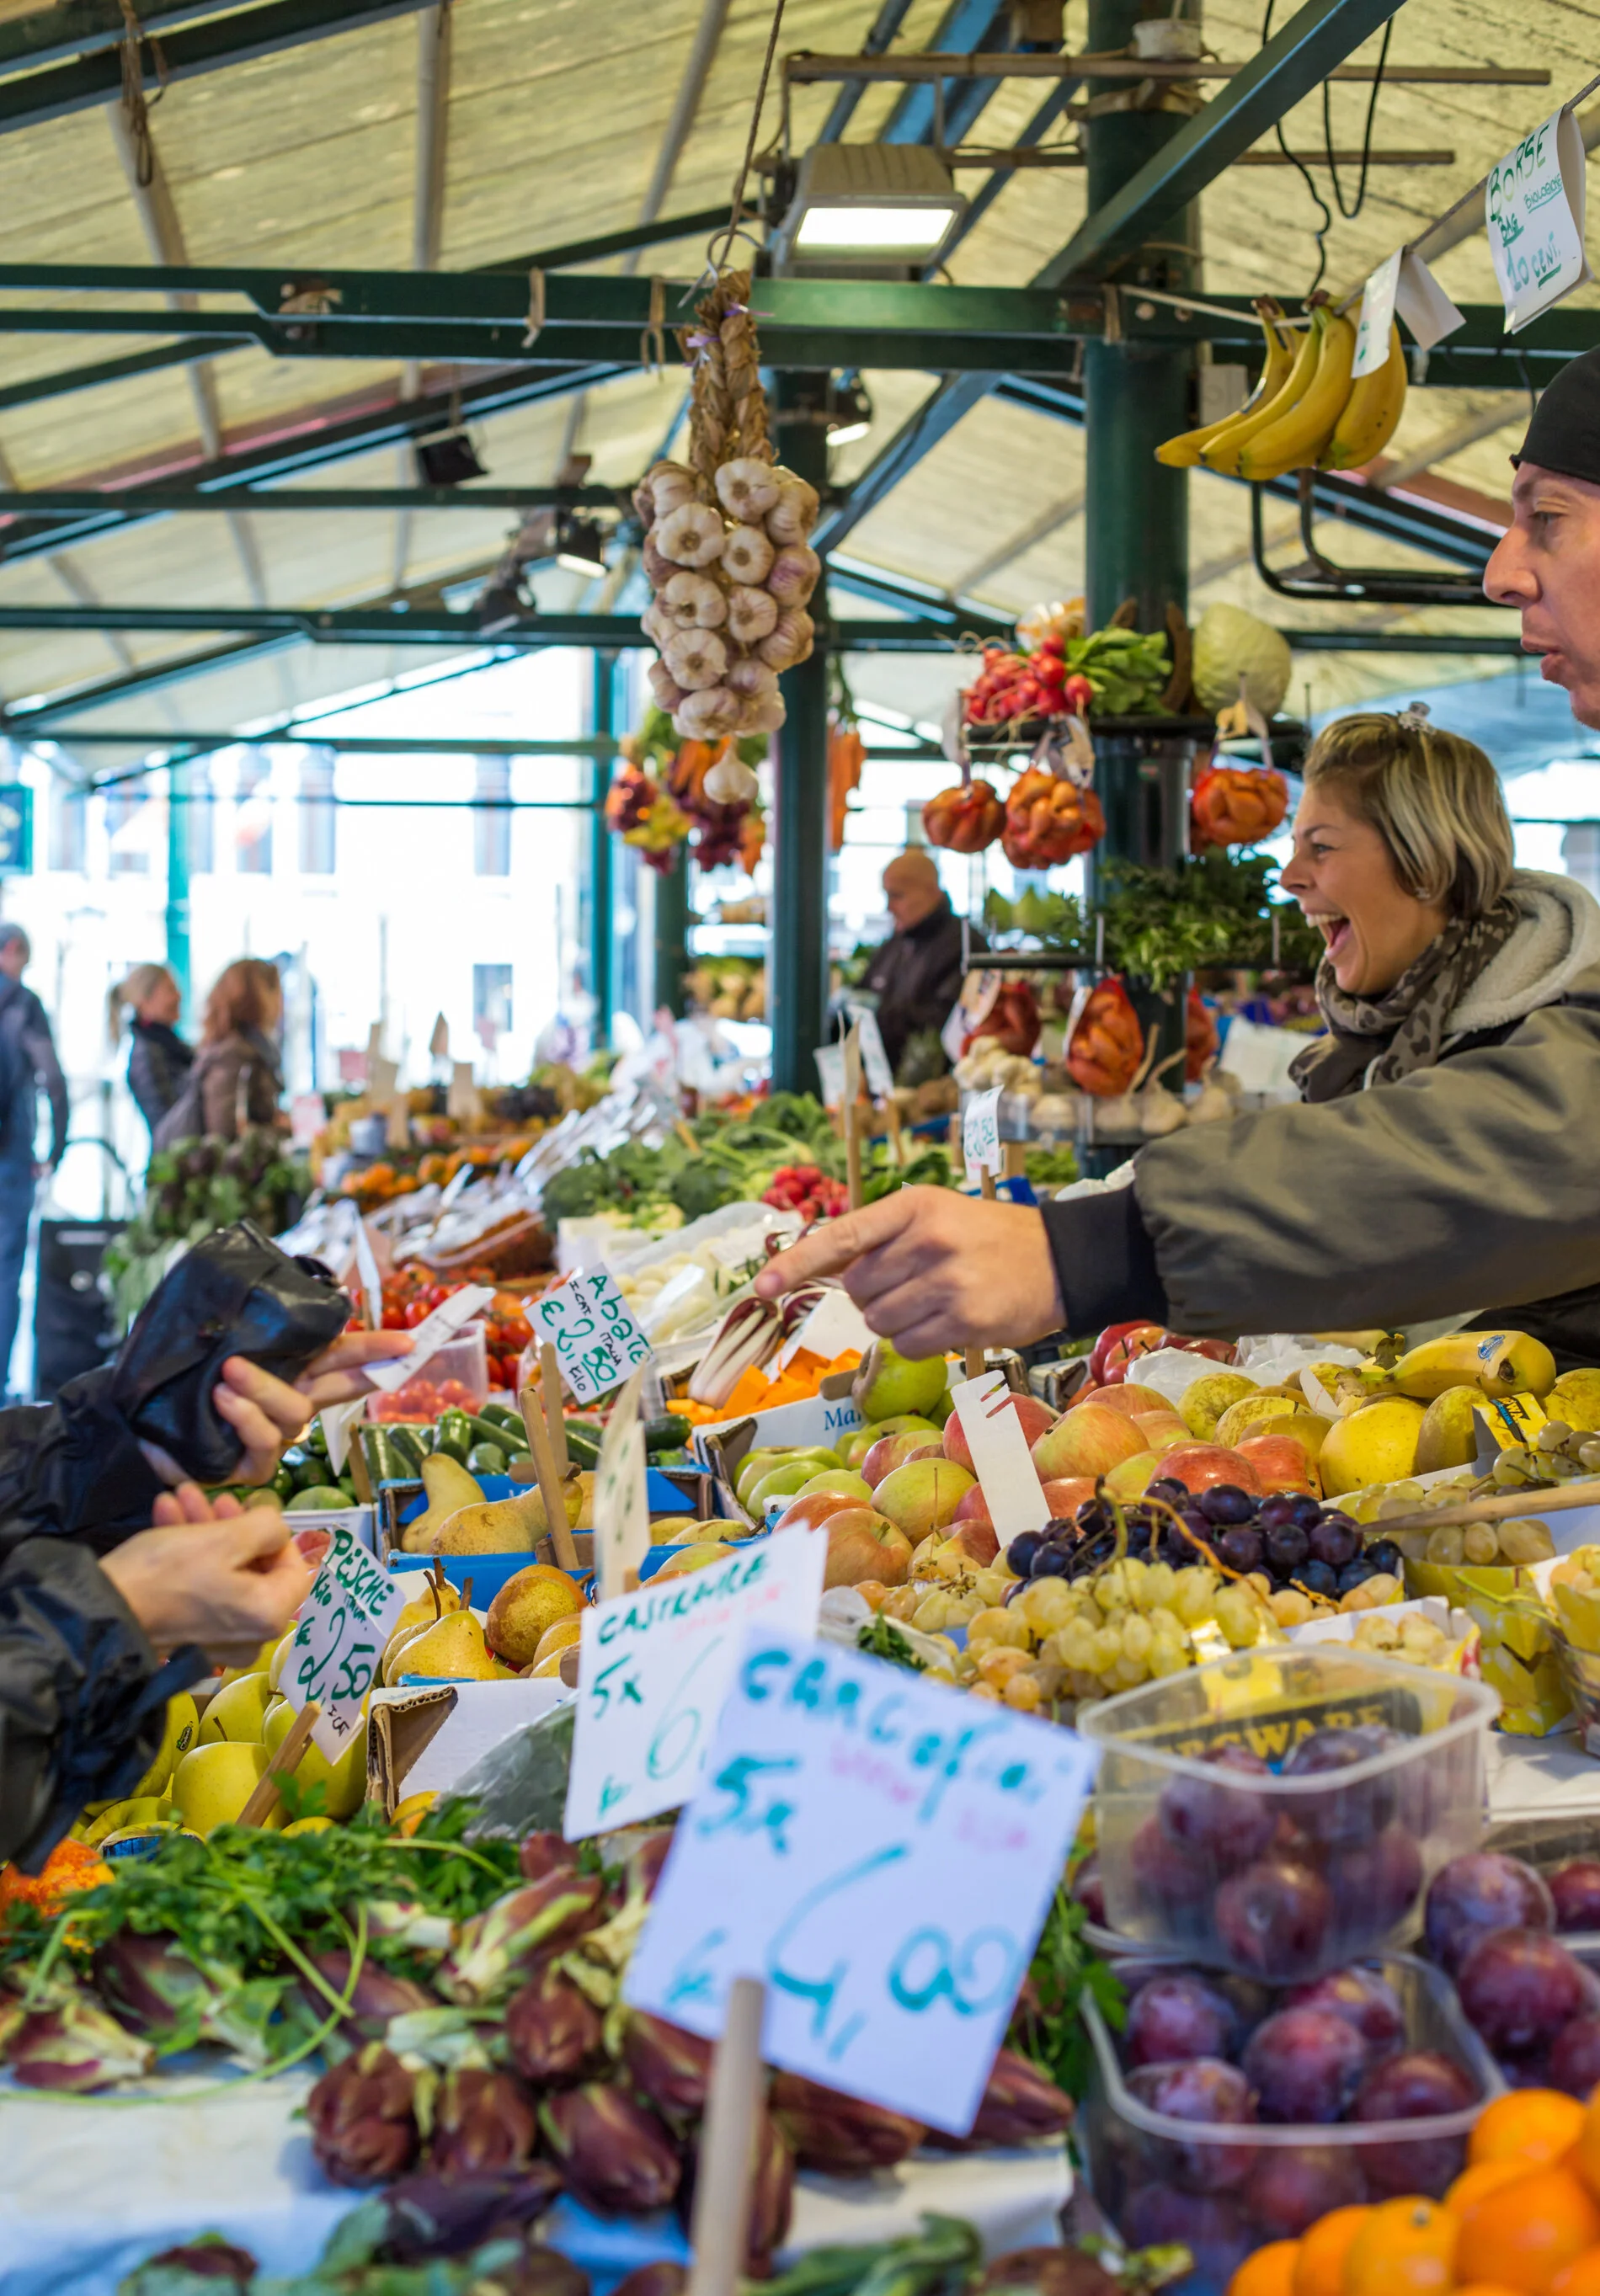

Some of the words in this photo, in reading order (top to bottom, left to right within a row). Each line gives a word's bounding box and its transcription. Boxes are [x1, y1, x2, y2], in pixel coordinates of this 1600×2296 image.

[1489, 124, 1549, 221] BORSE
[1498, 213, 1518, 242] BAG
[1507, 246, 1529, 292] 10
[541, 1301, 565, 1327] €
